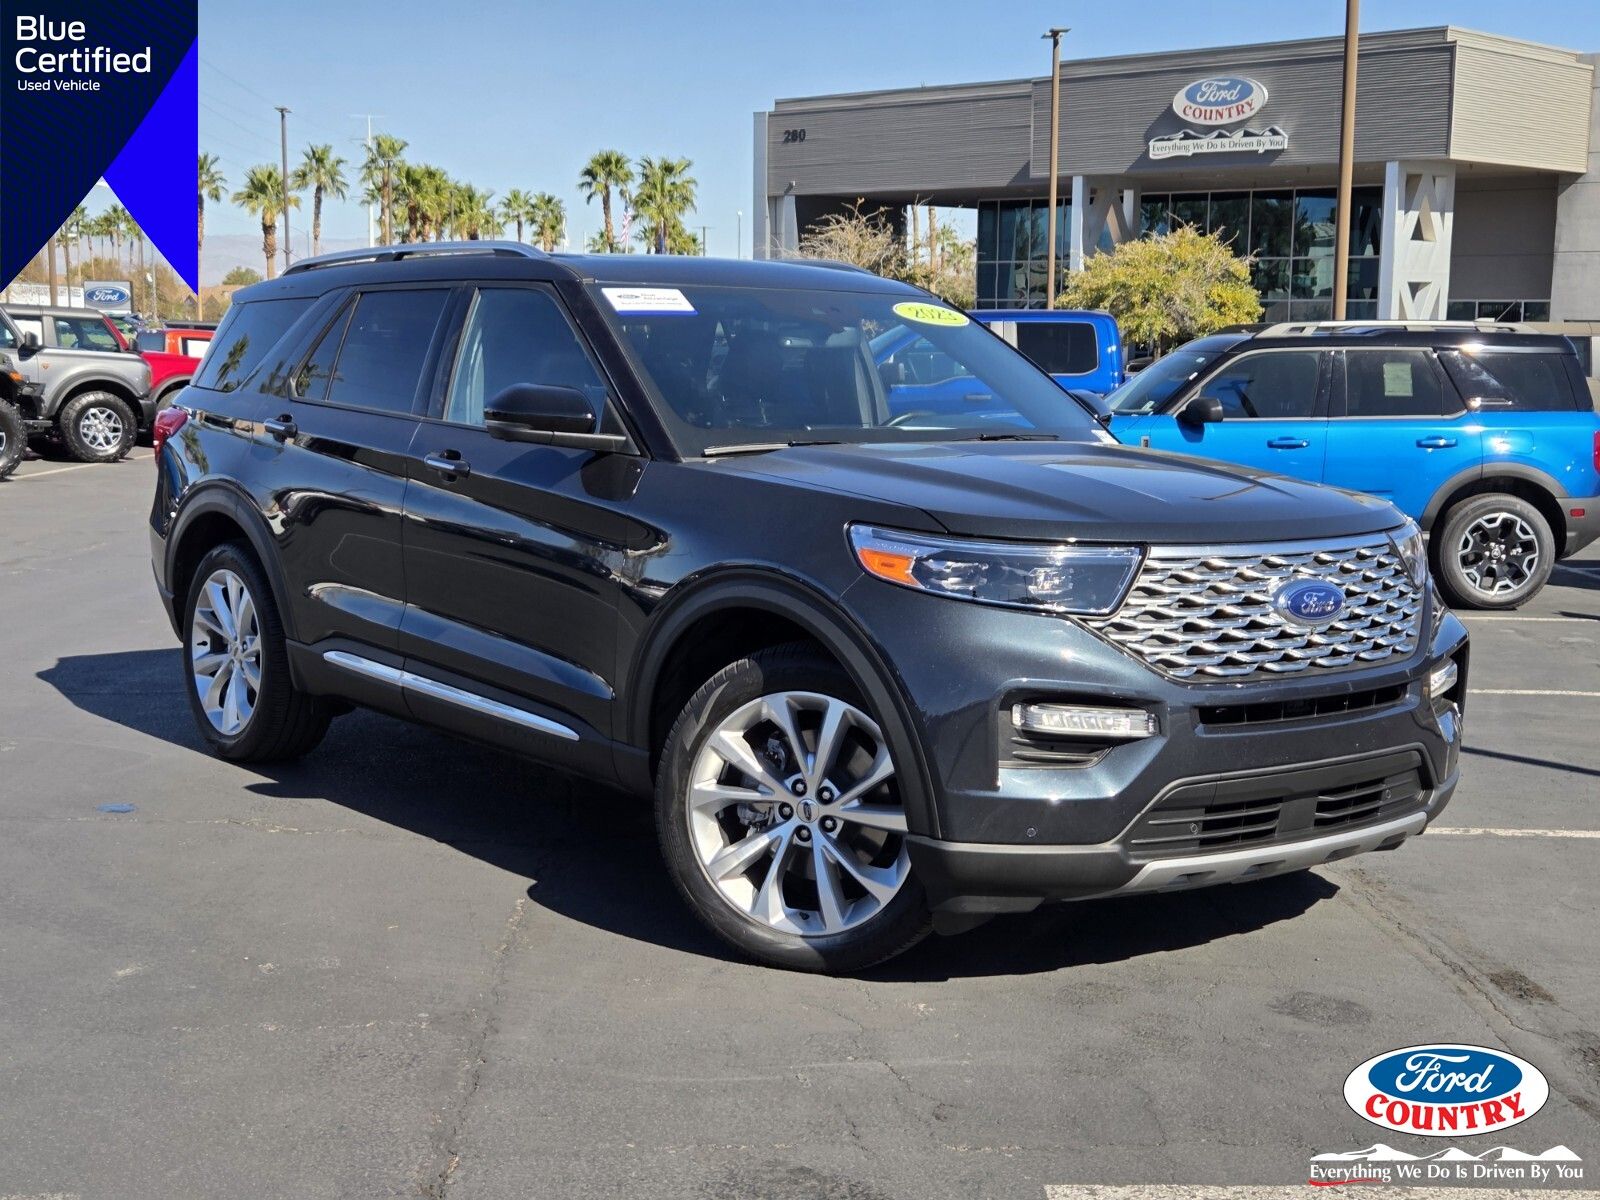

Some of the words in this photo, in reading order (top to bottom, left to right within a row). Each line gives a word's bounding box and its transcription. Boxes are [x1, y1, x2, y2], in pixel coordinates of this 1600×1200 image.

[1196, 80, 1242, 103] Ford
[1182, 98, 1256, 121] COUNTRY
[783, 129, 806, 144] 280
[1152, 142, 1190, 154] Everything
[1192, 141, 1204, 150] We
[1206, 140, 1218, 150] Do
[1220, 140, 1226, 149] Is
[1228, 139, 1254, 149] Driven
[1256, 138, 1266, 149] By
[1268, 137, 1283, 147] You
[92, 288, 120, 302] Ford
[1301, 591, 1335, 614] Ford
